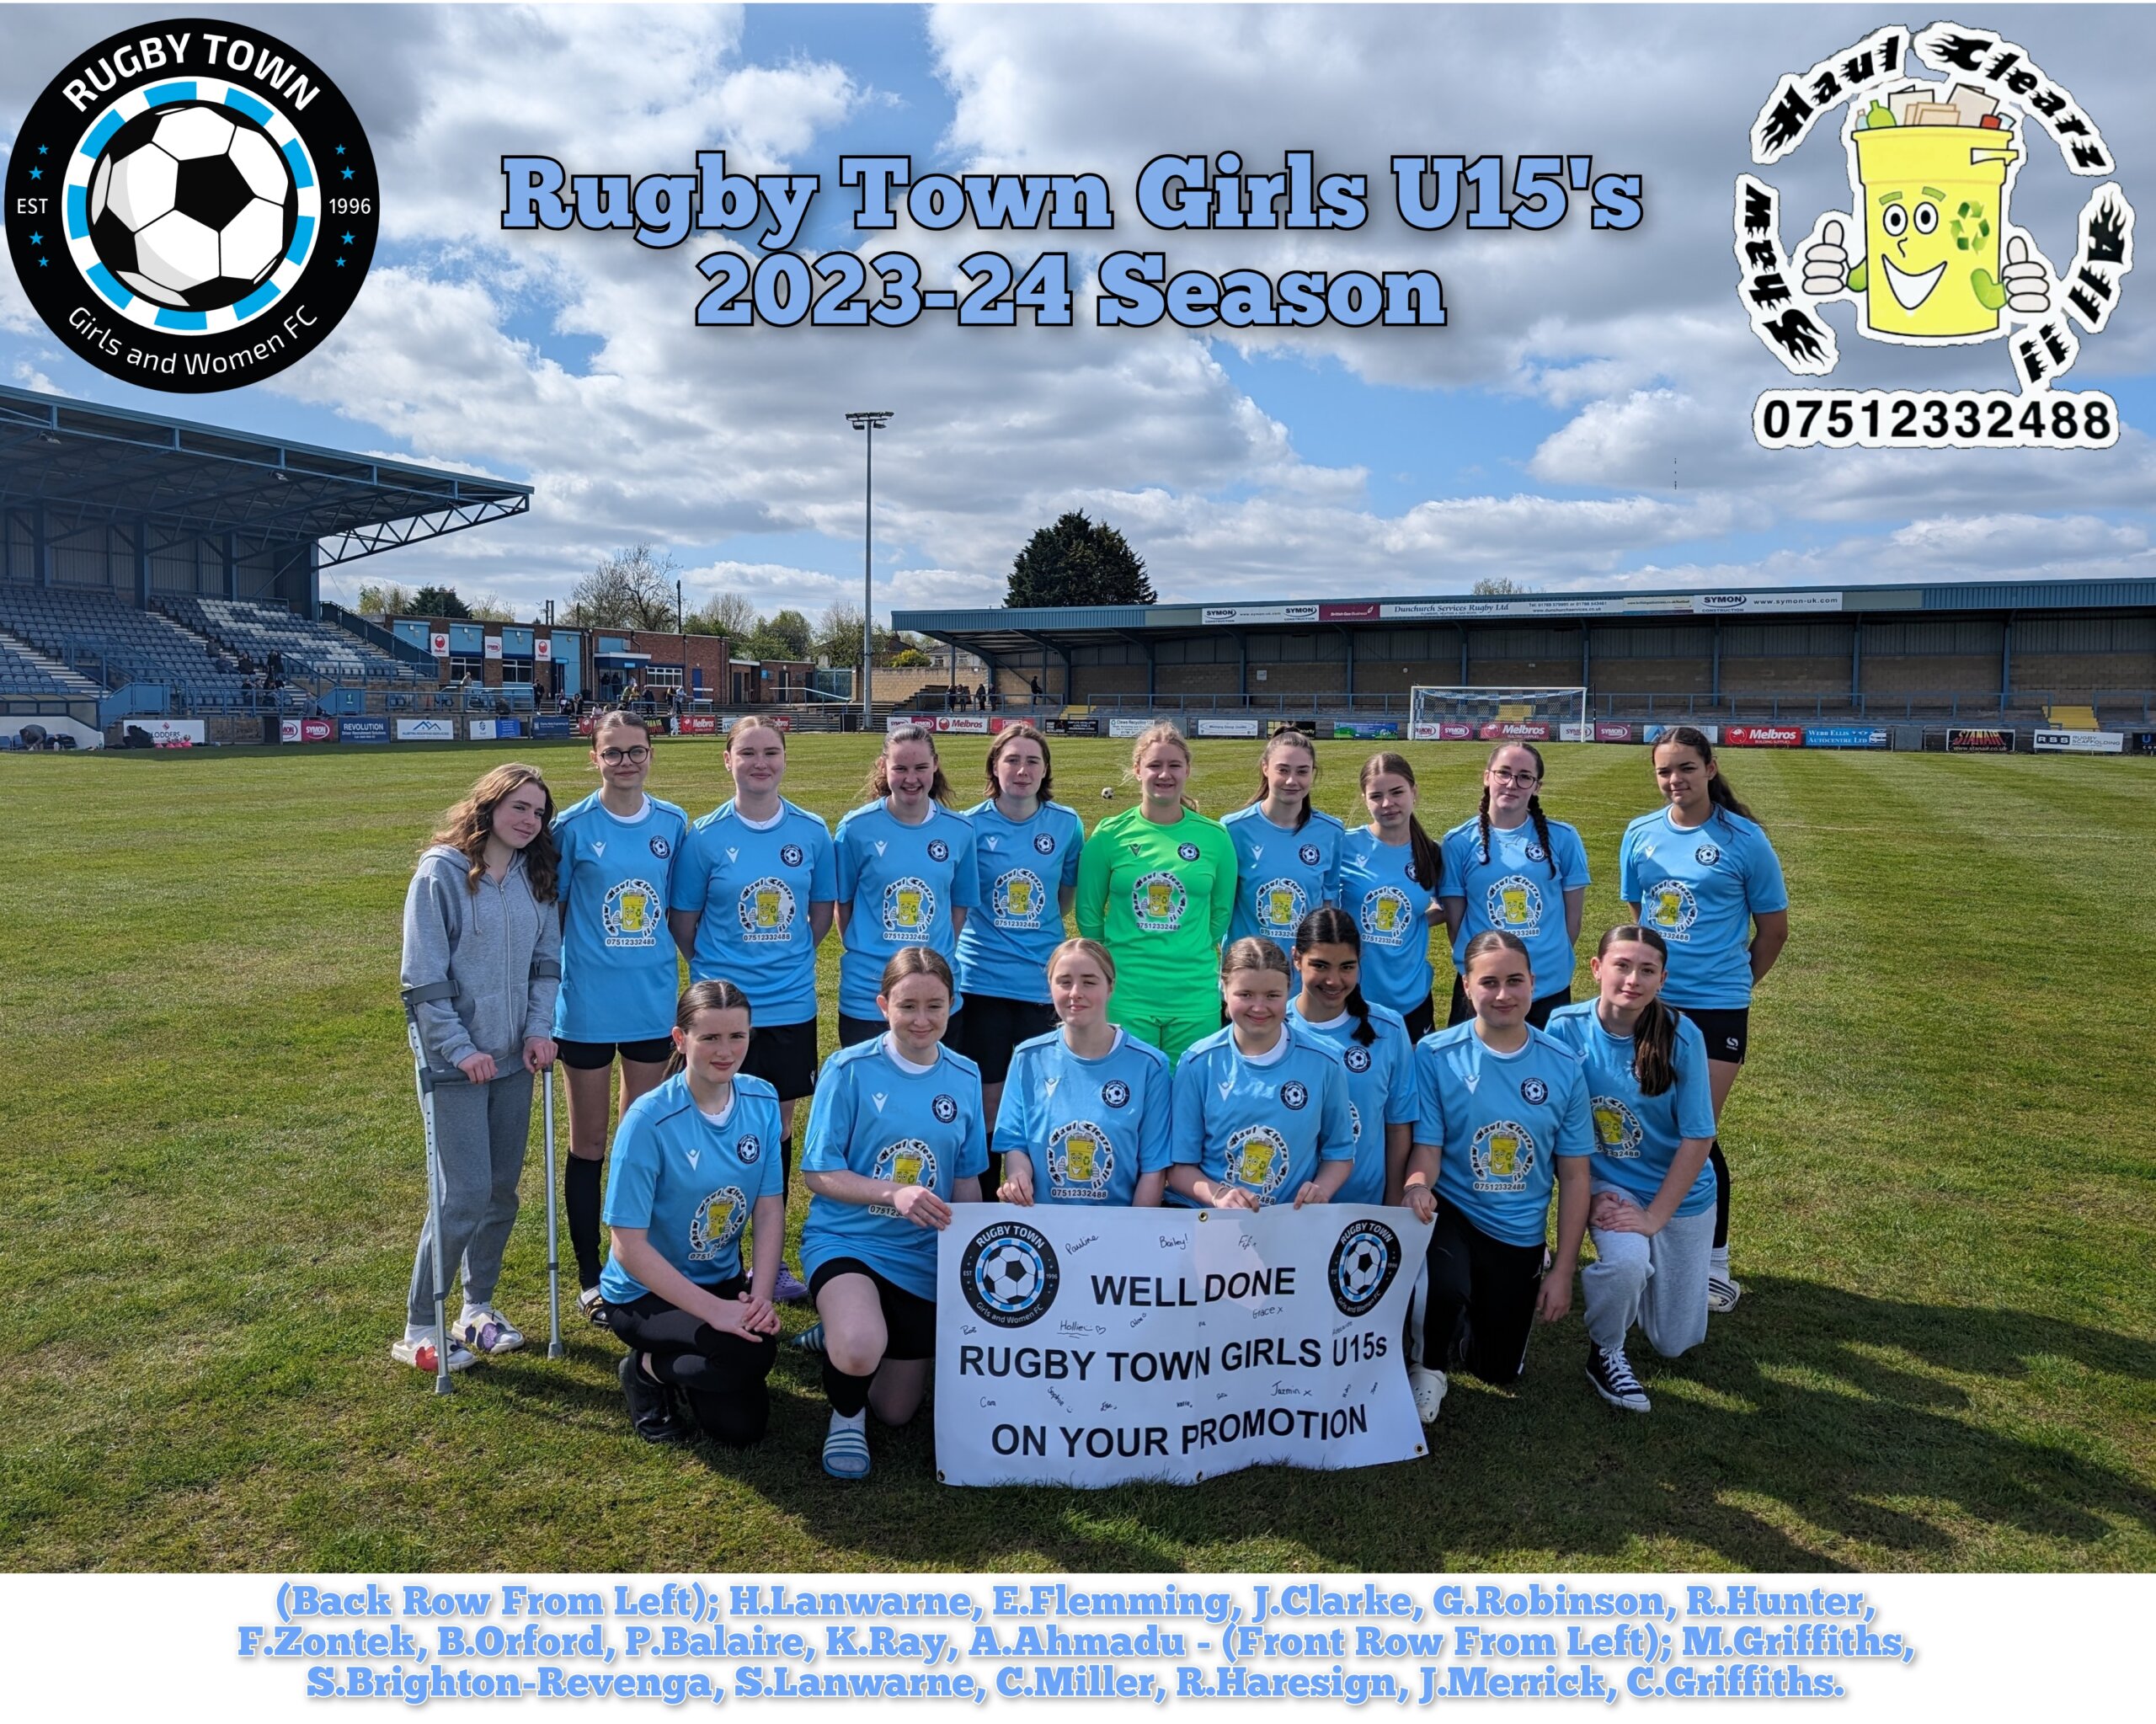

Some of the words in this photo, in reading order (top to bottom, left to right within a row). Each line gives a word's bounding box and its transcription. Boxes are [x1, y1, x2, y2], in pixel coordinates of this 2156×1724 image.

[1704, 595, 1742, 604] SYMON
[1753, 597, 1838, 606] www.symon-uk.com
[1395, 605, 1435, 613] Dunchurch
[1469, 604, 1493, 614] Rugby
[693, 718, 714, 728] Melbros
[952, 719, 983, 729] Melbros
[1502, 724, 1545, 734] Melbros
[306, 726, 326, 734] SYMON
[1749, 729, 1796, 739] Melbros
[1953, 729, 2005, 745] STANAIR
[1051, 1189, 1107, 1198] 07512332488
[975, 1225, 1011, 1247] RUGBY
[1013, 1225, 1045, 1249] TOWN
[1341, 1222, 1368, 1245] RUGBY
[1369, 1223, 1393, 1242] TOWN
[1065, 1235, 1099, 1256] Pauline
[1091, 1274, 1198, 1307] WELL
[1203, 1267, 1296, 1304] DONE
[976, 1301, 992, 1317] Girls
[991, 1313, 1006, 1323] and
[1006, 1310, 1035, 1324] Women
[1033, 1304, 1043, 1316] FC
[960, 1345, 1097, 1381] RUGBY
[1107, 1346, 1210, 1383] TOWN
[1221, 1337, 1321, 1371] GIRLS
[1332, 1332, 1388, 1368] U15s
[1270, 1381, 1300, 1396] Jazmin
[991, 1423, 1046, 1456] ON
[1059, 1426, 1170, 1459] YOUR
[1182, 1404, 1368, 1455] PROMOTION
